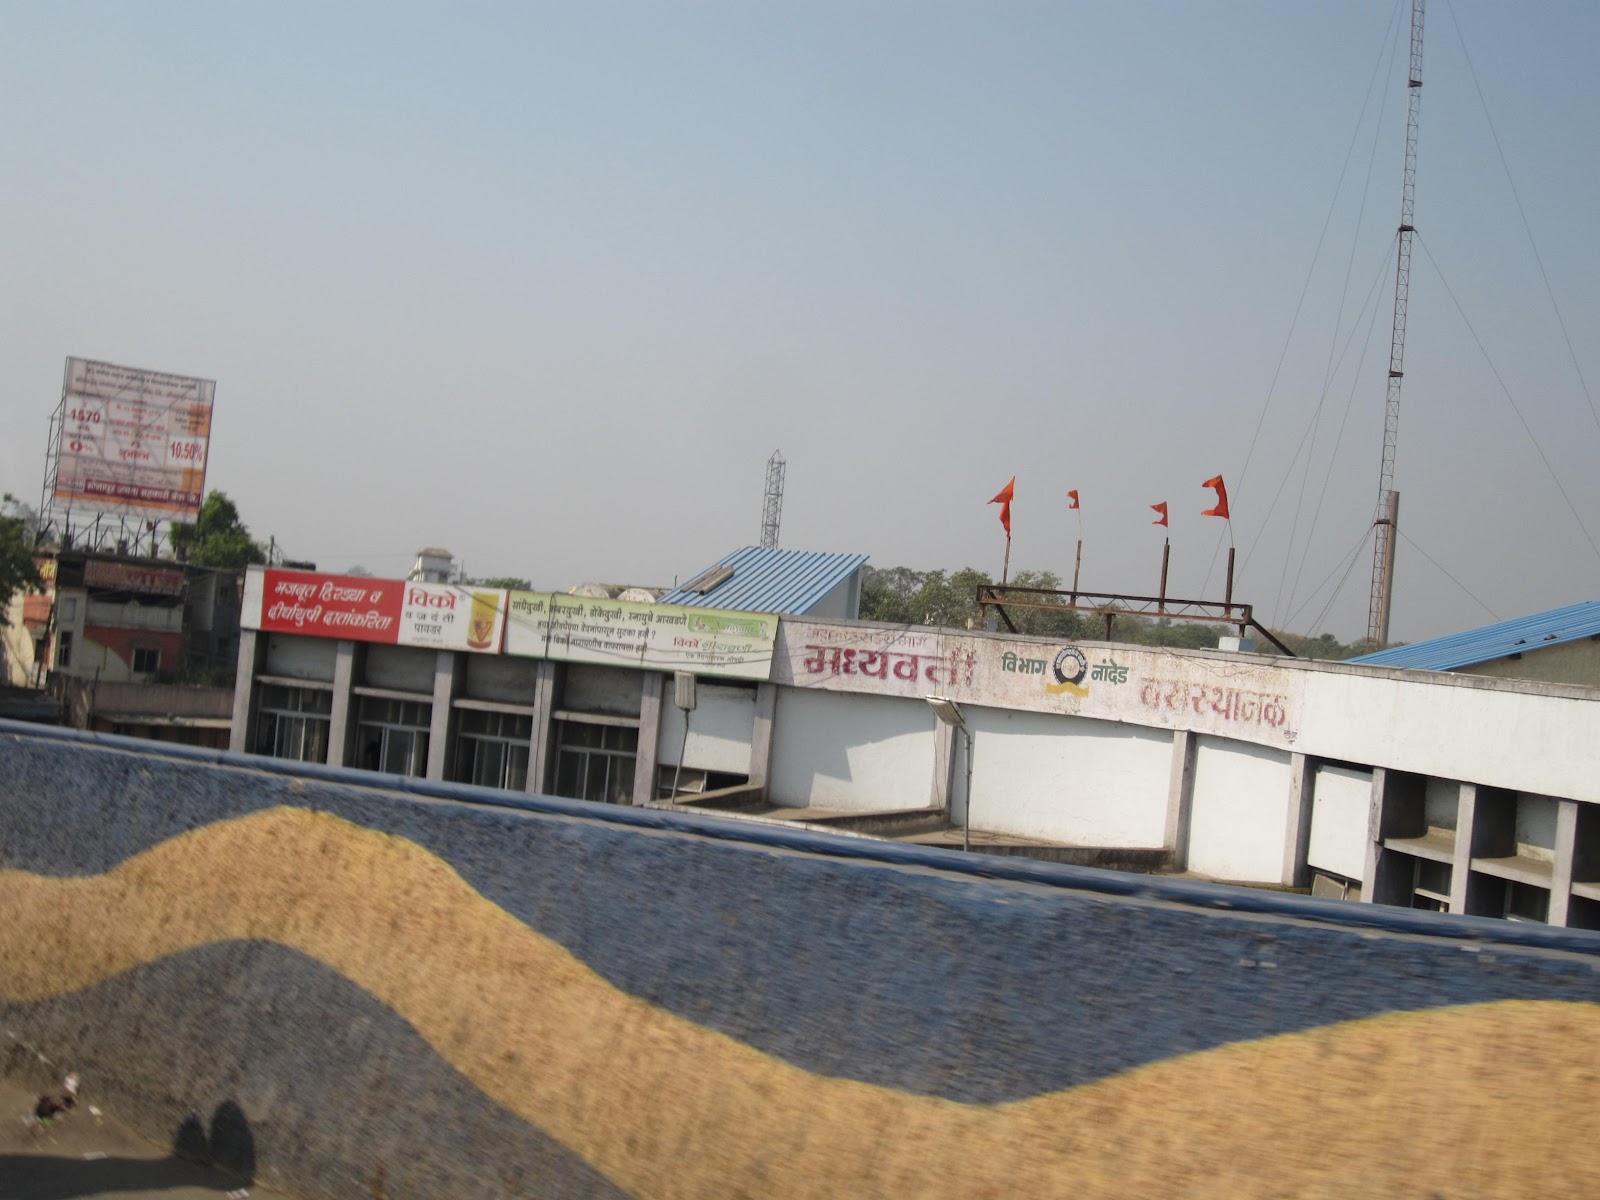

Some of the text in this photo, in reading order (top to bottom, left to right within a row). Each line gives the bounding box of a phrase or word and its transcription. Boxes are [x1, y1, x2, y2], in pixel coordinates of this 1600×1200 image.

[171, 440, 203, 462] 10.50%
[275, 581, 317, 603] मजबूत
[370, 590, 383, 604] व
[408, 588, 456, 610] विको
[323, 608, 393, 630] दातांकरिता
[414, 623, 442, 635] पावडर
[673, 637, 699, 648] विको
[1001, 651, 1048, 676] विभाग
[1091, 658, 1130, 686] नांदेड
